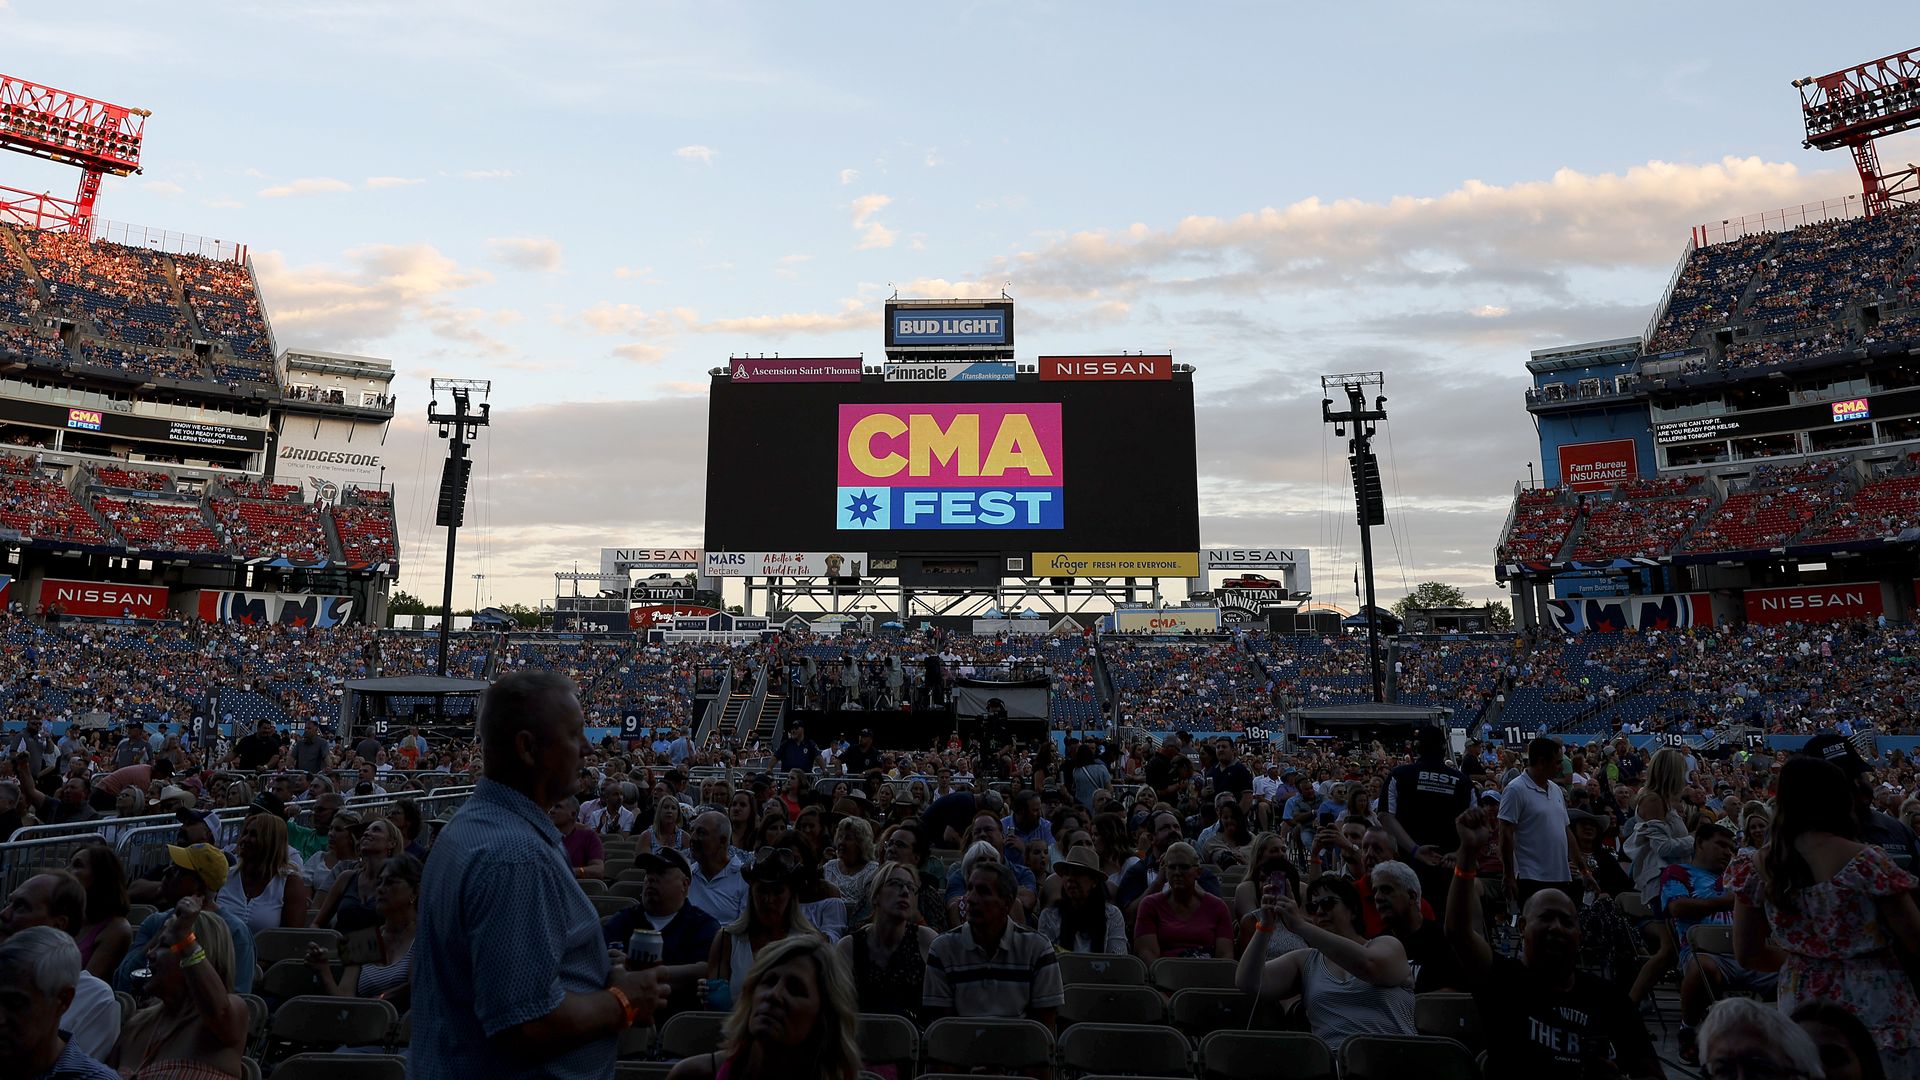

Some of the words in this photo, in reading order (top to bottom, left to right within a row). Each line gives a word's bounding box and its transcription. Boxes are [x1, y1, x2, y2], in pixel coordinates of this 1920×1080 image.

[900, 320, 940, 334] BUD
[942, 320, 998, 334] LIGHT
[752, 366, 798, 375] Ascension
[800, 366, 823, 375] Saint
[824, 366, 860, 375] Thomas
[886, 365, 946, 380] Pinnacle
[1057, 362, 1154, 375] NISSAN
[962, 372, 1014, 380] TitansBanking.com
[1833, 400, 1867, 414] CMA
[70, 411, 100, 423] CMA
[1844, 412, 1867, 420] FEST
[78, 422, 100, 430] FEST
[1717, 422, 1740, 430] KELSEA
[170, 434, 197, 442] BALLERINI
[198, 437, 225, 445] TONIGHT?
[1658, 434, 1687, 443] BALLERINI
[848, 413, 1054, 478] CMA
[280, 446, 380, 466] BRIDGESTONE
[1570, 464, 1592, 472] Farm
[1595, 461, 1626, 470] Bureau
[1570, 469, 1627, 481] INSURANCE
[904, 490, 1052, 525] FEST
[616, 550, 696, 561] NISSAN
[708, 554, 746, 565] MARS
[764, 554, 770, 563] A
[772, 554, 793, 564] Better
[1210, 551, 1294, 561] NISSAN
[763, 566, 785, 575] World
[787, 566, 797, 575] For
[799, 566, 810, 575] Pets
[1051, 554, 1088, 575] Kroger
[708, 567, 739, 575] Petcare
[58, 588, 152, 606] NISSAN
[649, 589, 684, 599] TITAN
[1241, 590, 1278, 599] TITAN
[1761, 592, 1863, 610] NISSAN
[651, 610, 673, 623] Party
[1150, 619, 1177, 628] CMA
[209, 698, 217, 728] 3
[376, 721, 387, 733] 15
[626, 716, 637, 731] 9
[1246, 726, 1260, 739] 18
[1260, 730, 1268, 738] 21
[1504, 726, 1521, 744] 11
[1668, 734, 1682, 746] 19
[1746, 735, 1762, 747] 13
[1823, 742, 1845, 754] BEST
[1419, 771, 1459, 785] BEST
[1560, 1006, 1588, 1026] WITH
[1528, 1016, 1562, 1051] THE
